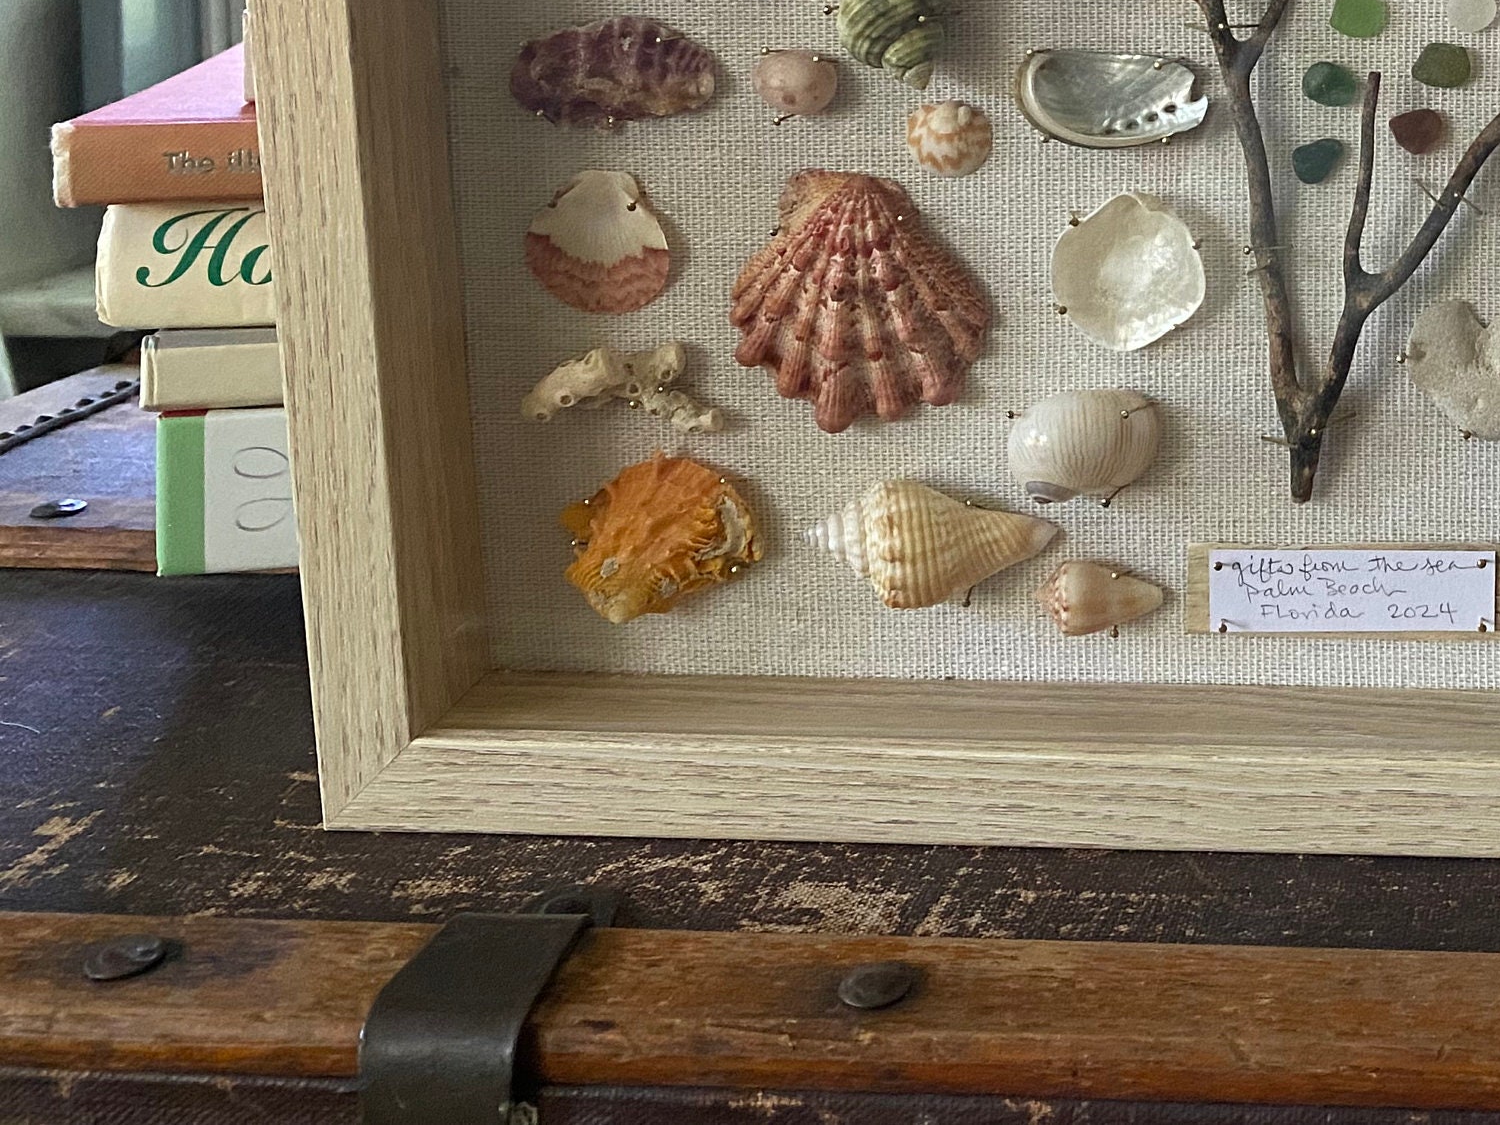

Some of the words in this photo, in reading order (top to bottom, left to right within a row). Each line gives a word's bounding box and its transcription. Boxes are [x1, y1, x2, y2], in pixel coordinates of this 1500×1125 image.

[163, 150, 215, 174] The
[1298, 553, 1359, 581] from
[1368, 555, 1418, 573] the
[1420, 557, 1478, 576] sea
[1387, 602, 1457, 624] 2024
